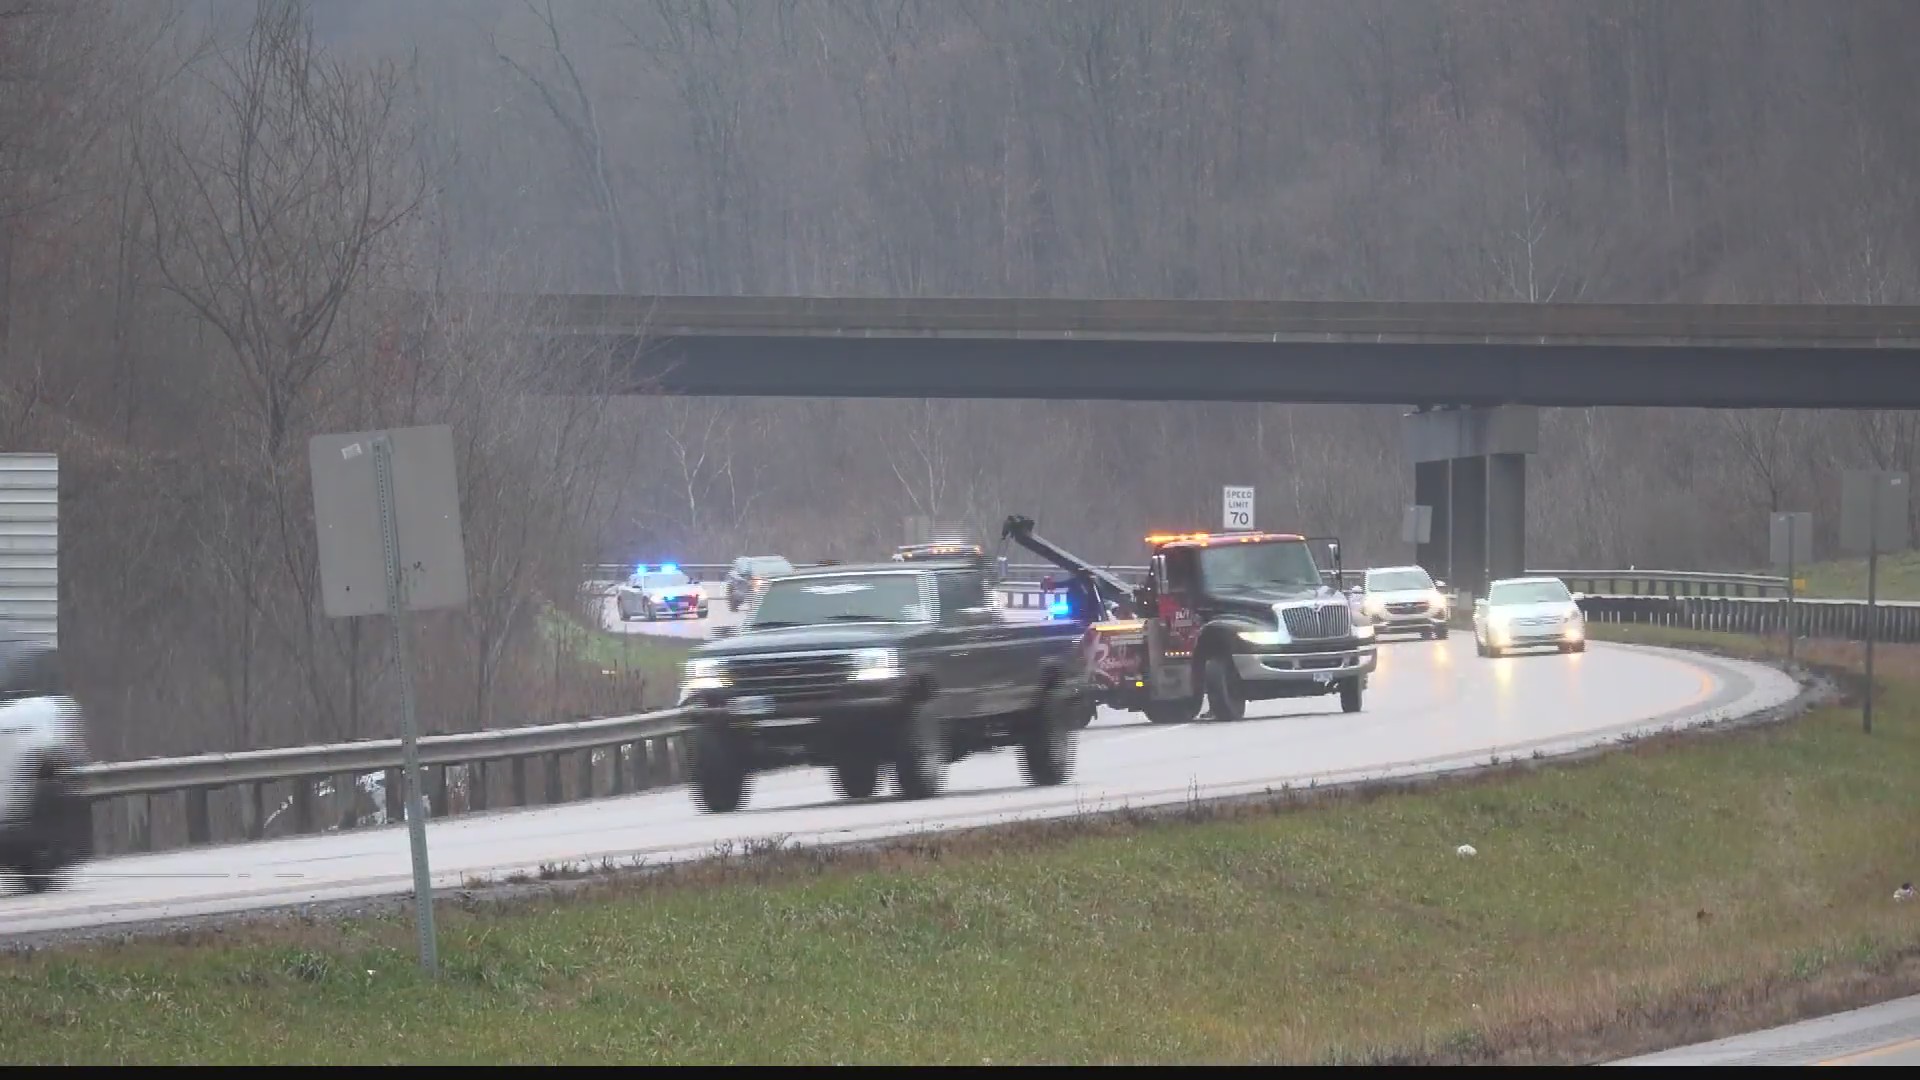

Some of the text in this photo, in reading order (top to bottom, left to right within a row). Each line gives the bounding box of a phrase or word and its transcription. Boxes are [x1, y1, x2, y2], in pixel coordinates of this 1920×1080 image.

[1226, 490, 1252, 499] SPEED
[1228, 501, 1249, 509] LIMIT
[1230, 511, 1249, 525] 70
